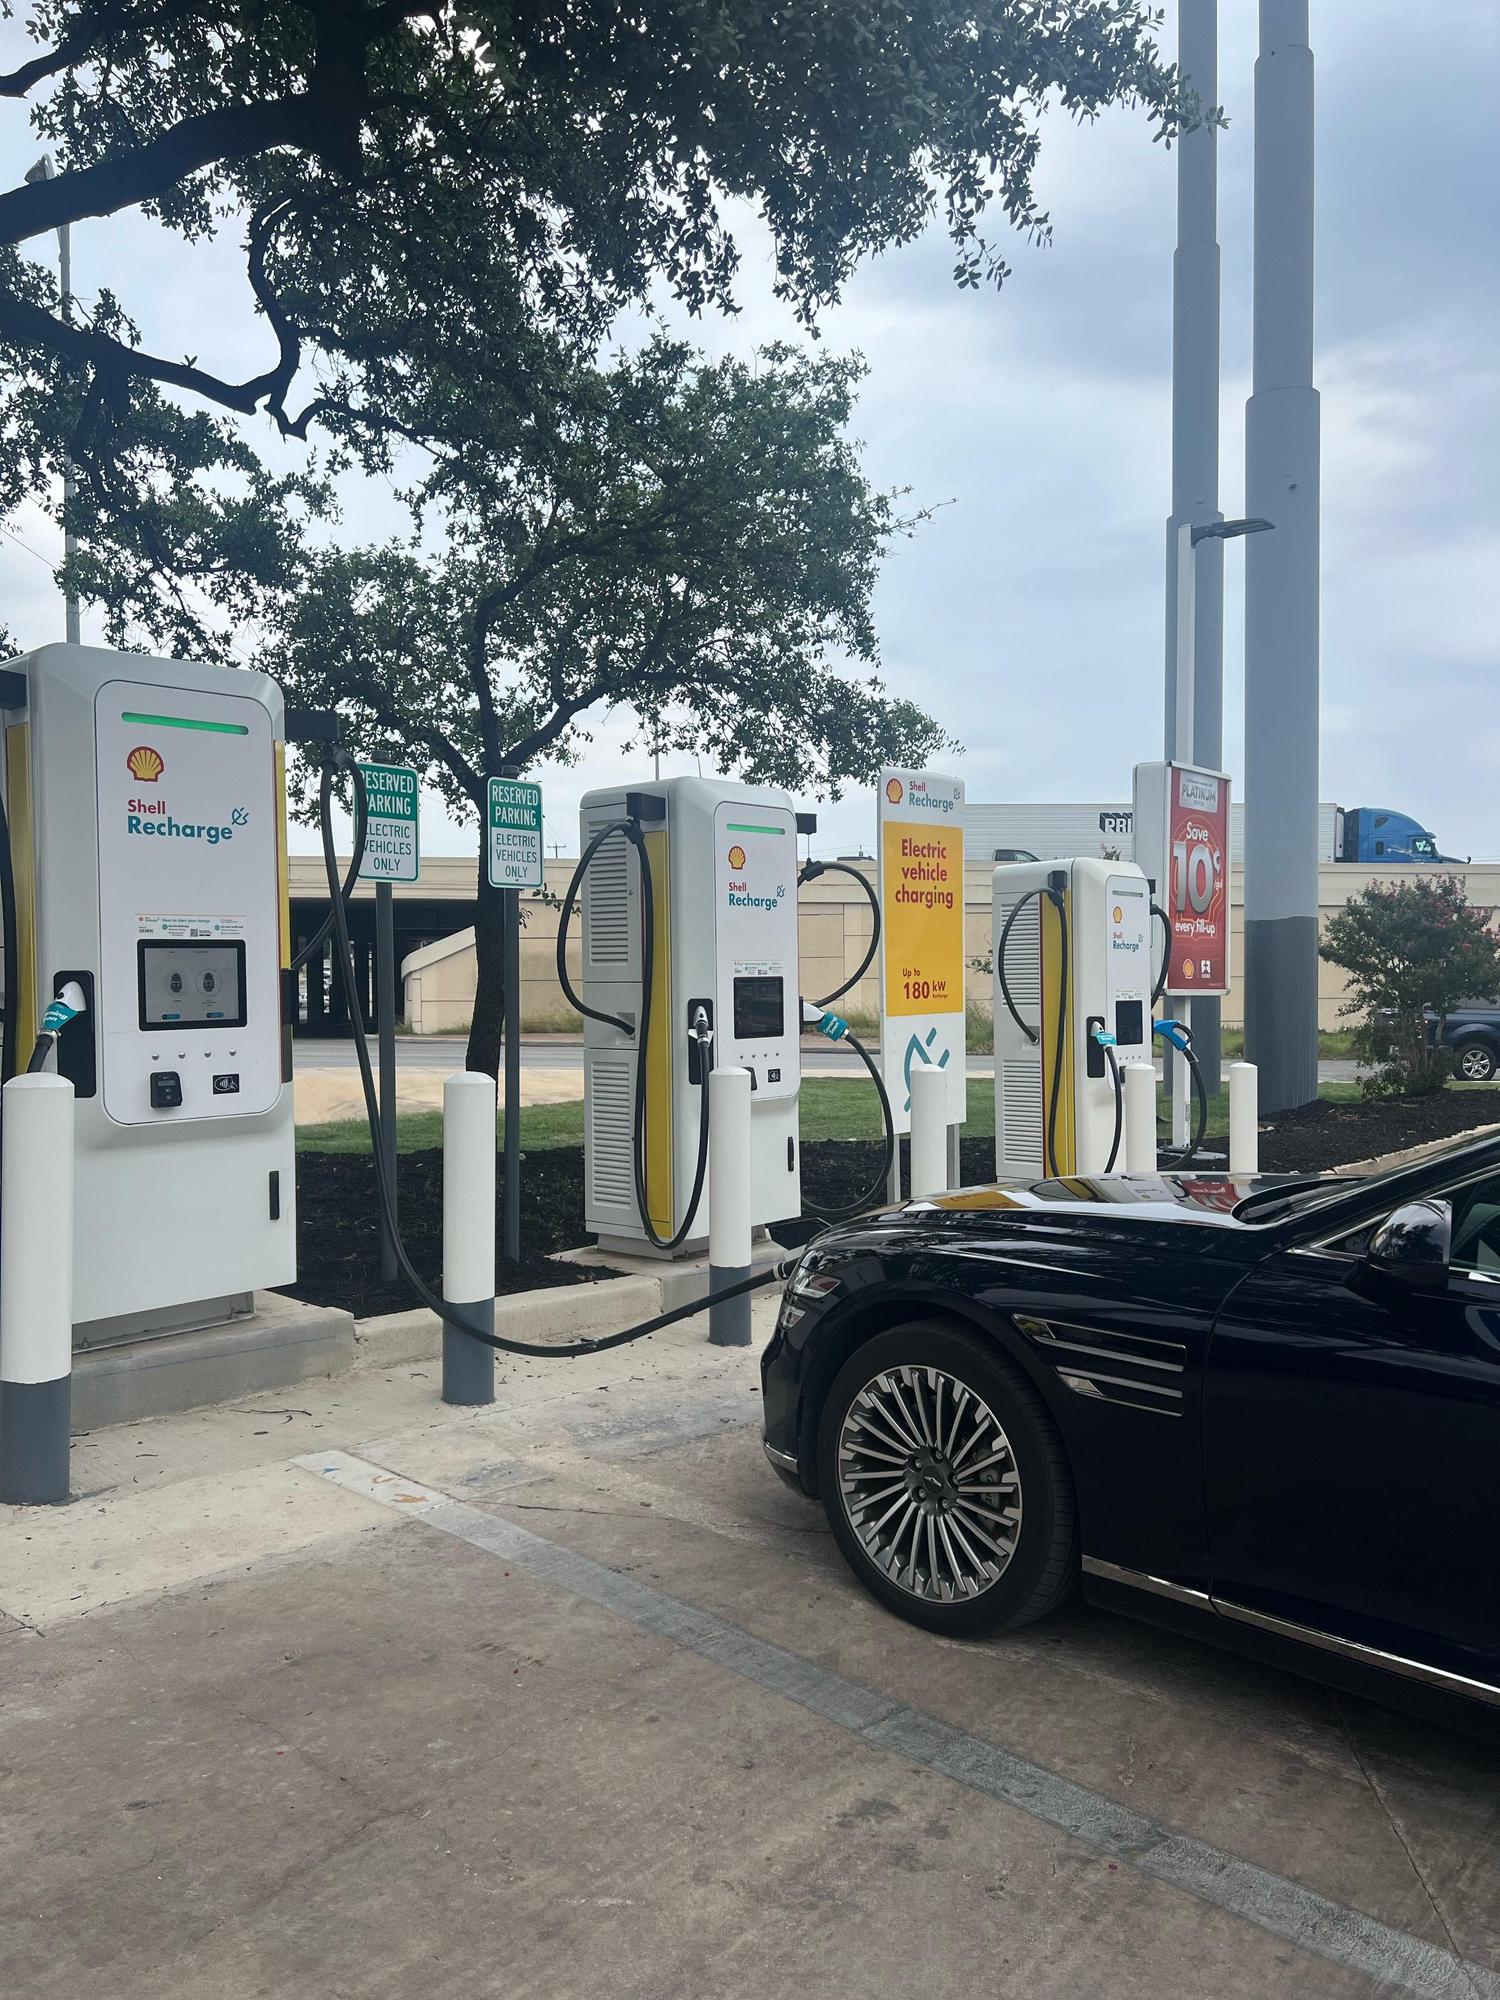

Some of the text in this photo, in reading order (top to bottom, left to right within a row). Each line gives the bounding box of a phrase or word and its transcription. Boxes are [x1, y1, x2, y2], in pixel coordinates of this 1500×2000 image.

[361, 770, 414, 794] ESERVED
[909, 781, 926, 792] Shell
[492, 785, 539, 807] RESERVED
[909, 792, 954, 813] Recharge
[1181, 783, 1216, 803] PLATINUM
[127, 799, 166, 815] Shell
[366, 794, 412, 816] ARKING
[495, 806, 537, 827] PARKING
[1099, 812, 1133, 833] PRI
[127, 815, 233, 845] Recharge
[1186, 821, 1209, 841] Save
[496, 833, 536, 848] ELECTRIC
[901, 837, 947, 860] Electric
[373, 857, 401, 872] ONLY
[495, 849, 537, 864] VEHICLES
[505, 865, 528, 878] ONLY
[901, 861, 948, 882] vehicle
[728, 882, 747, 892] Shell
[895, 883, 954, 910] charging
[728, 892, 778, 911] Recharge
[1112, 931, 1123, 939] Shell
[1174, 918, 1216, 938] every fill-up
[1112, 940, 1140, 953] Recharge
[902, 968, 921, 979] Up to
[903, 980, 946, 1000] 180 kW
